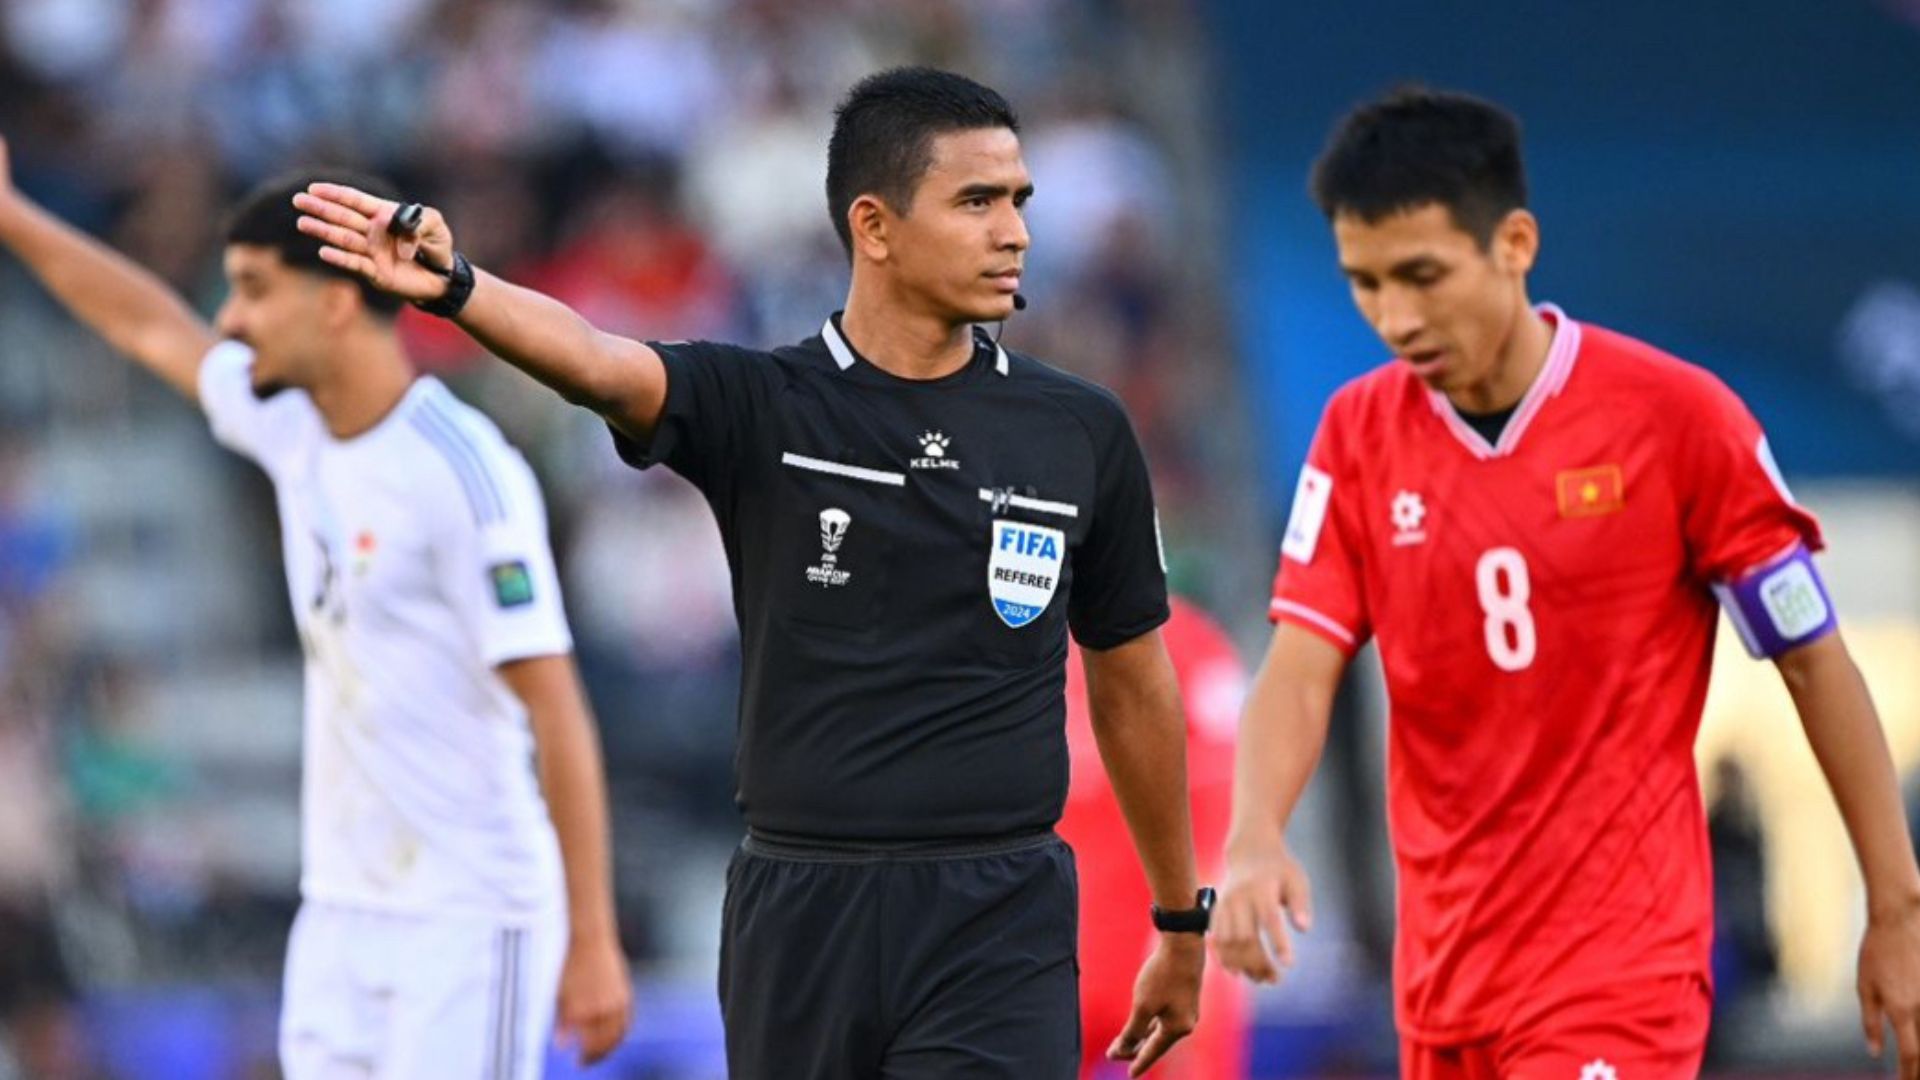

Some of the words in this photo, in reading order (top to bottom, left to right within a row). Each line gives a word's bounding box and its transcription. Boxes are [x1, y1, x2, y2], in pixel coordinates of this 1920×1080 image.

[1000, 527, 1057, 561] FIFA
[994, 566, 1053, 590] REFEREE
[1003, 603, 1031, 619] 2024
[1475, 546, 1537, 672] 8
